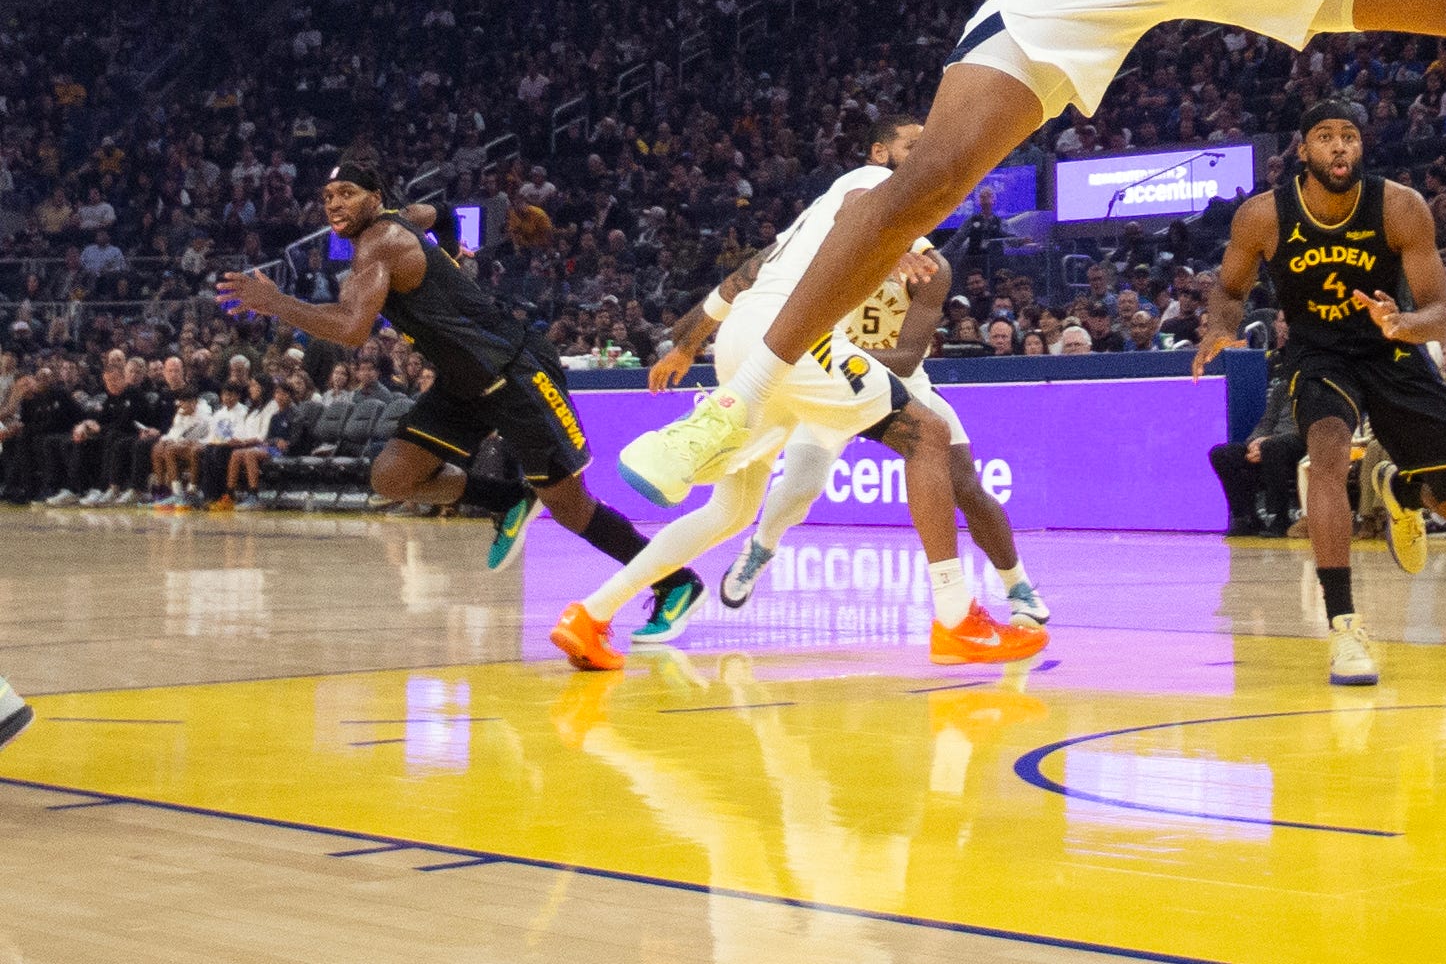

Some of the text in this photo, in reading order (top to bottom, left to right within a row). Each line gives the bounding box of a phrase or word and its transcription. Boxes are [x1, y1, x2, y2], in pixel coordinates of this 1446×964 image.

[1123, 179, 1218, 204] accenture
[1289, 245, 1377, 272] GOLDEN
[1322, 271, 1347, 299] 4
[862, 306, 880, 334] 5
[532, 371, 586, 450] WARRIORS
